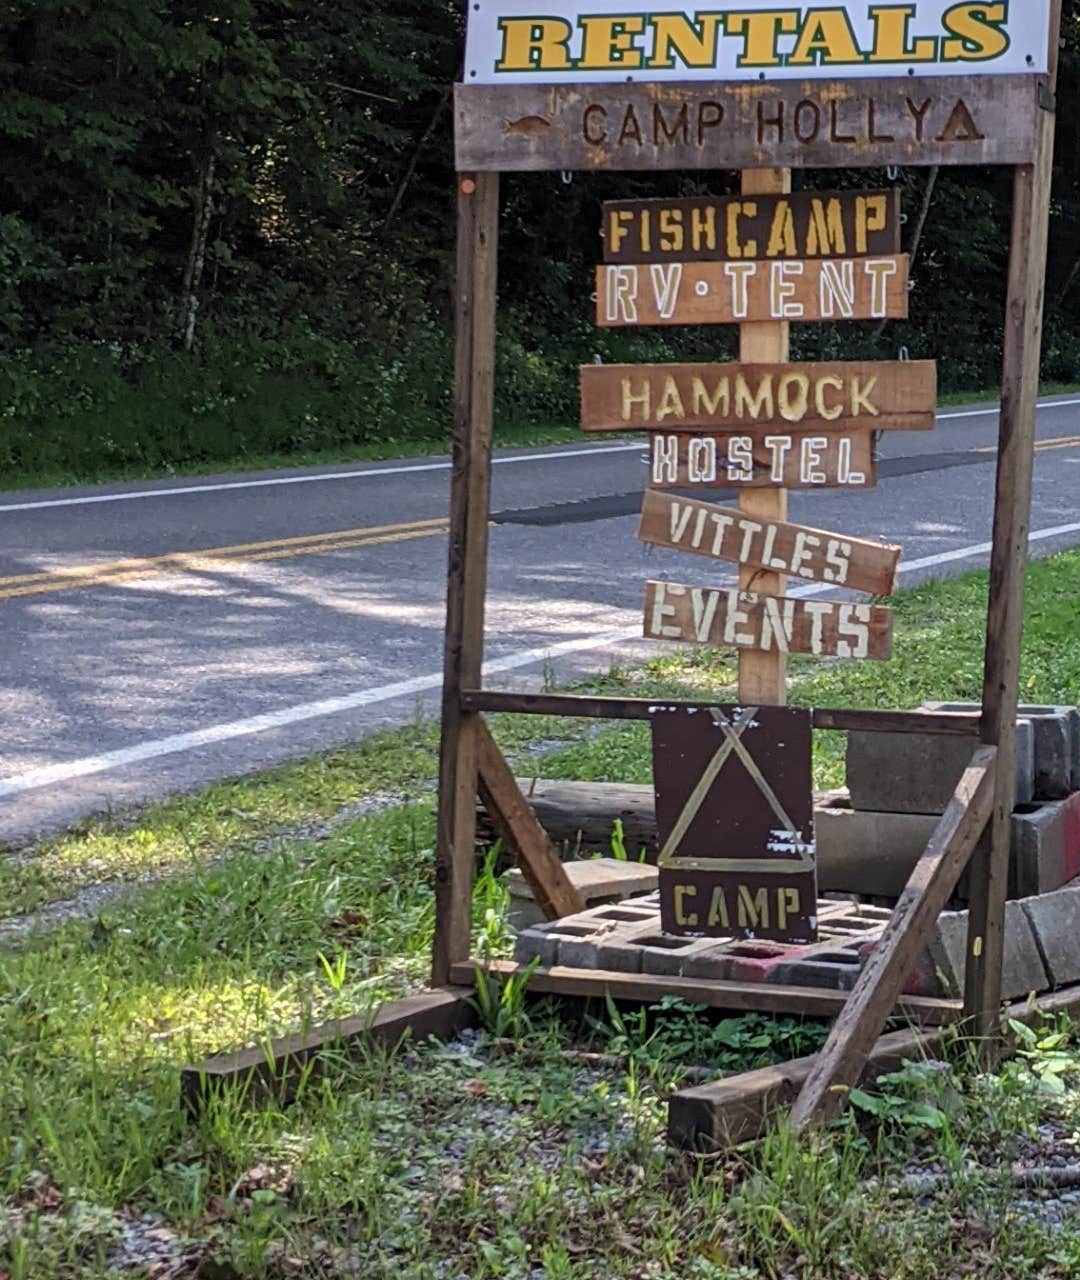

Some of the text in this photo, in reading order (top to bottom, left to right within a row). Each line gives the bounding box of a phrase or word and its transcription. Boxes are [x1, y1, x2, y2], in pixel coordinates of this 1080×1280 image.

[495, 0, 1010, 72] RENTALS
[581, 97, 937, 146] CAMP HOLLY
[621, 372, 879, 421] HAMMOCK
[652, 436, 865, 484] HOSTEL
[670, 502, 851, 584] VITTLES
[650, 584, 870, 658] EVENTS
[674, 885, 800, 930] CAMP
